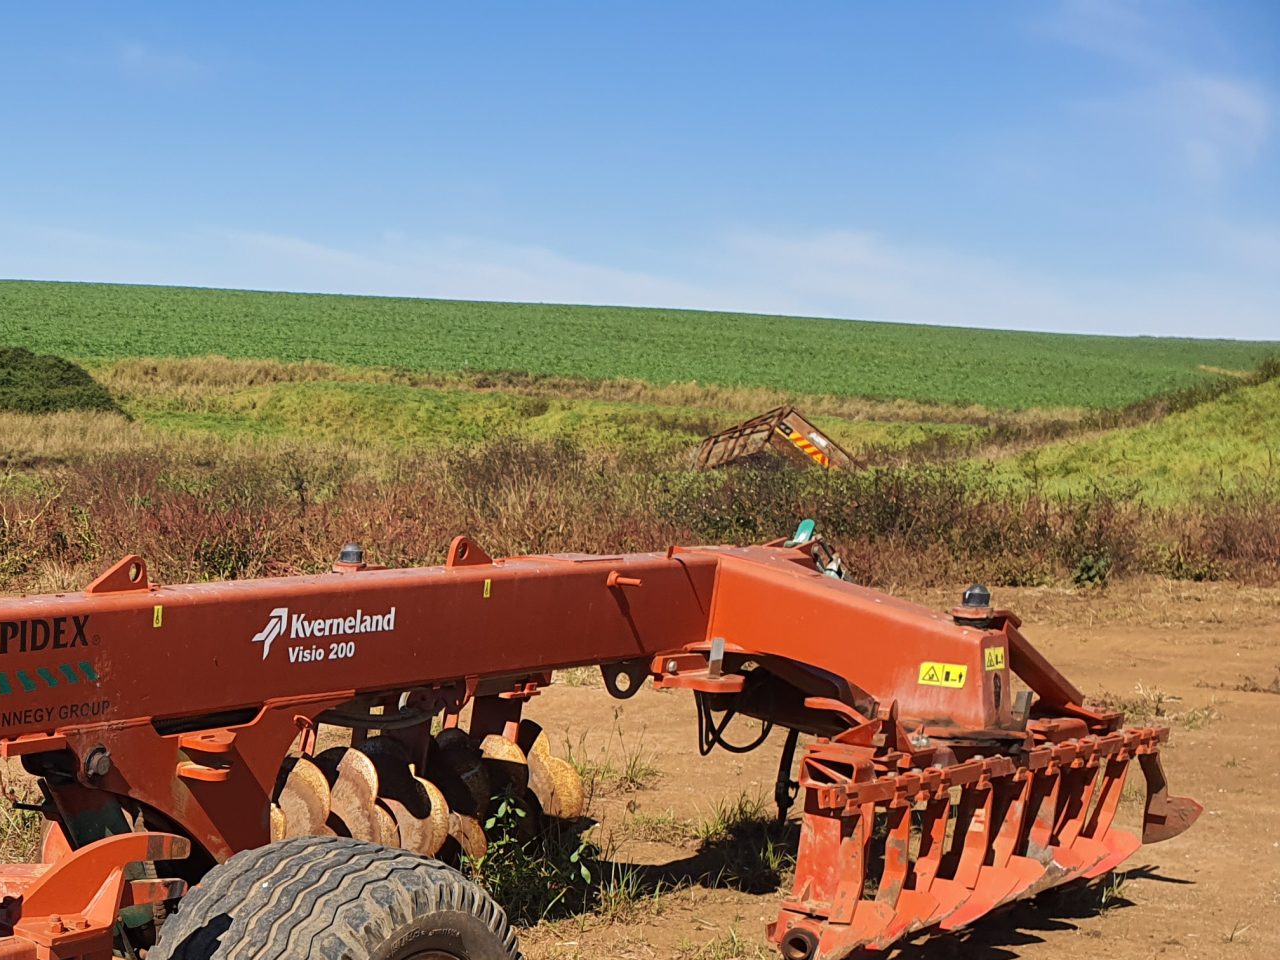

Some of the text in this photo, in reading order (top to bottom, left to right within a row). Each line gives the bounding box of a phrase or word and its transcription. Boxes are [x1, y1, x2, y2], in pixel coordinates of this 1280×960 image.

[290, 606, 396, 639] Kverneland
[288, 641, 355, 663] Visio 200
[58, 700, 111, 720] GROUP
